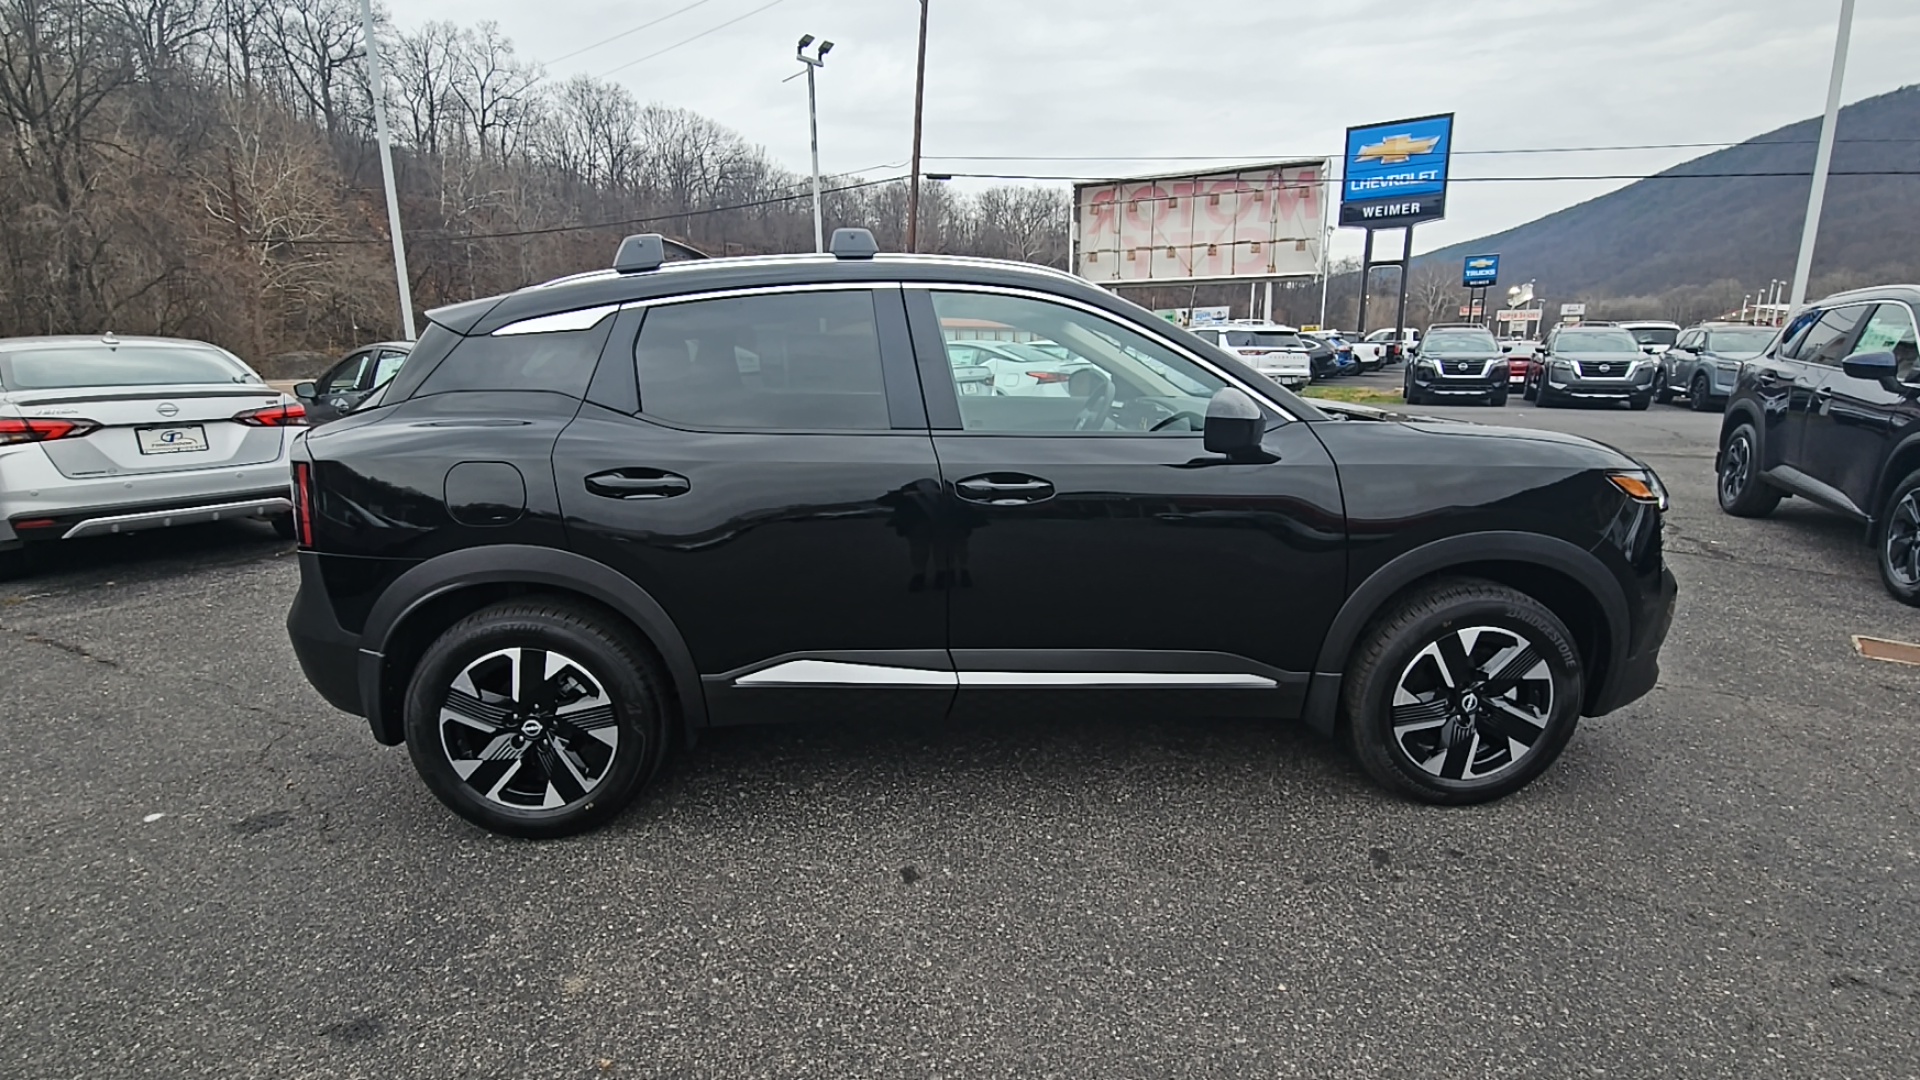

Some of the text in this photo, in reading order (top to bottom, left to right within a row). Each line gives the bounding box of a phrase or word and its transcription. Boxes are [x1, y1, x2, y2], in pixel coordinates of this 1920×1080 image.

[1350, 169, 1439, 191] CHEVROLET
[1362, 202, 1421, 218] WEIMER
[1465, 268, 1496, 277] TRUCKS
[1505, 607, 1577, 669] BRIDGESTONE
